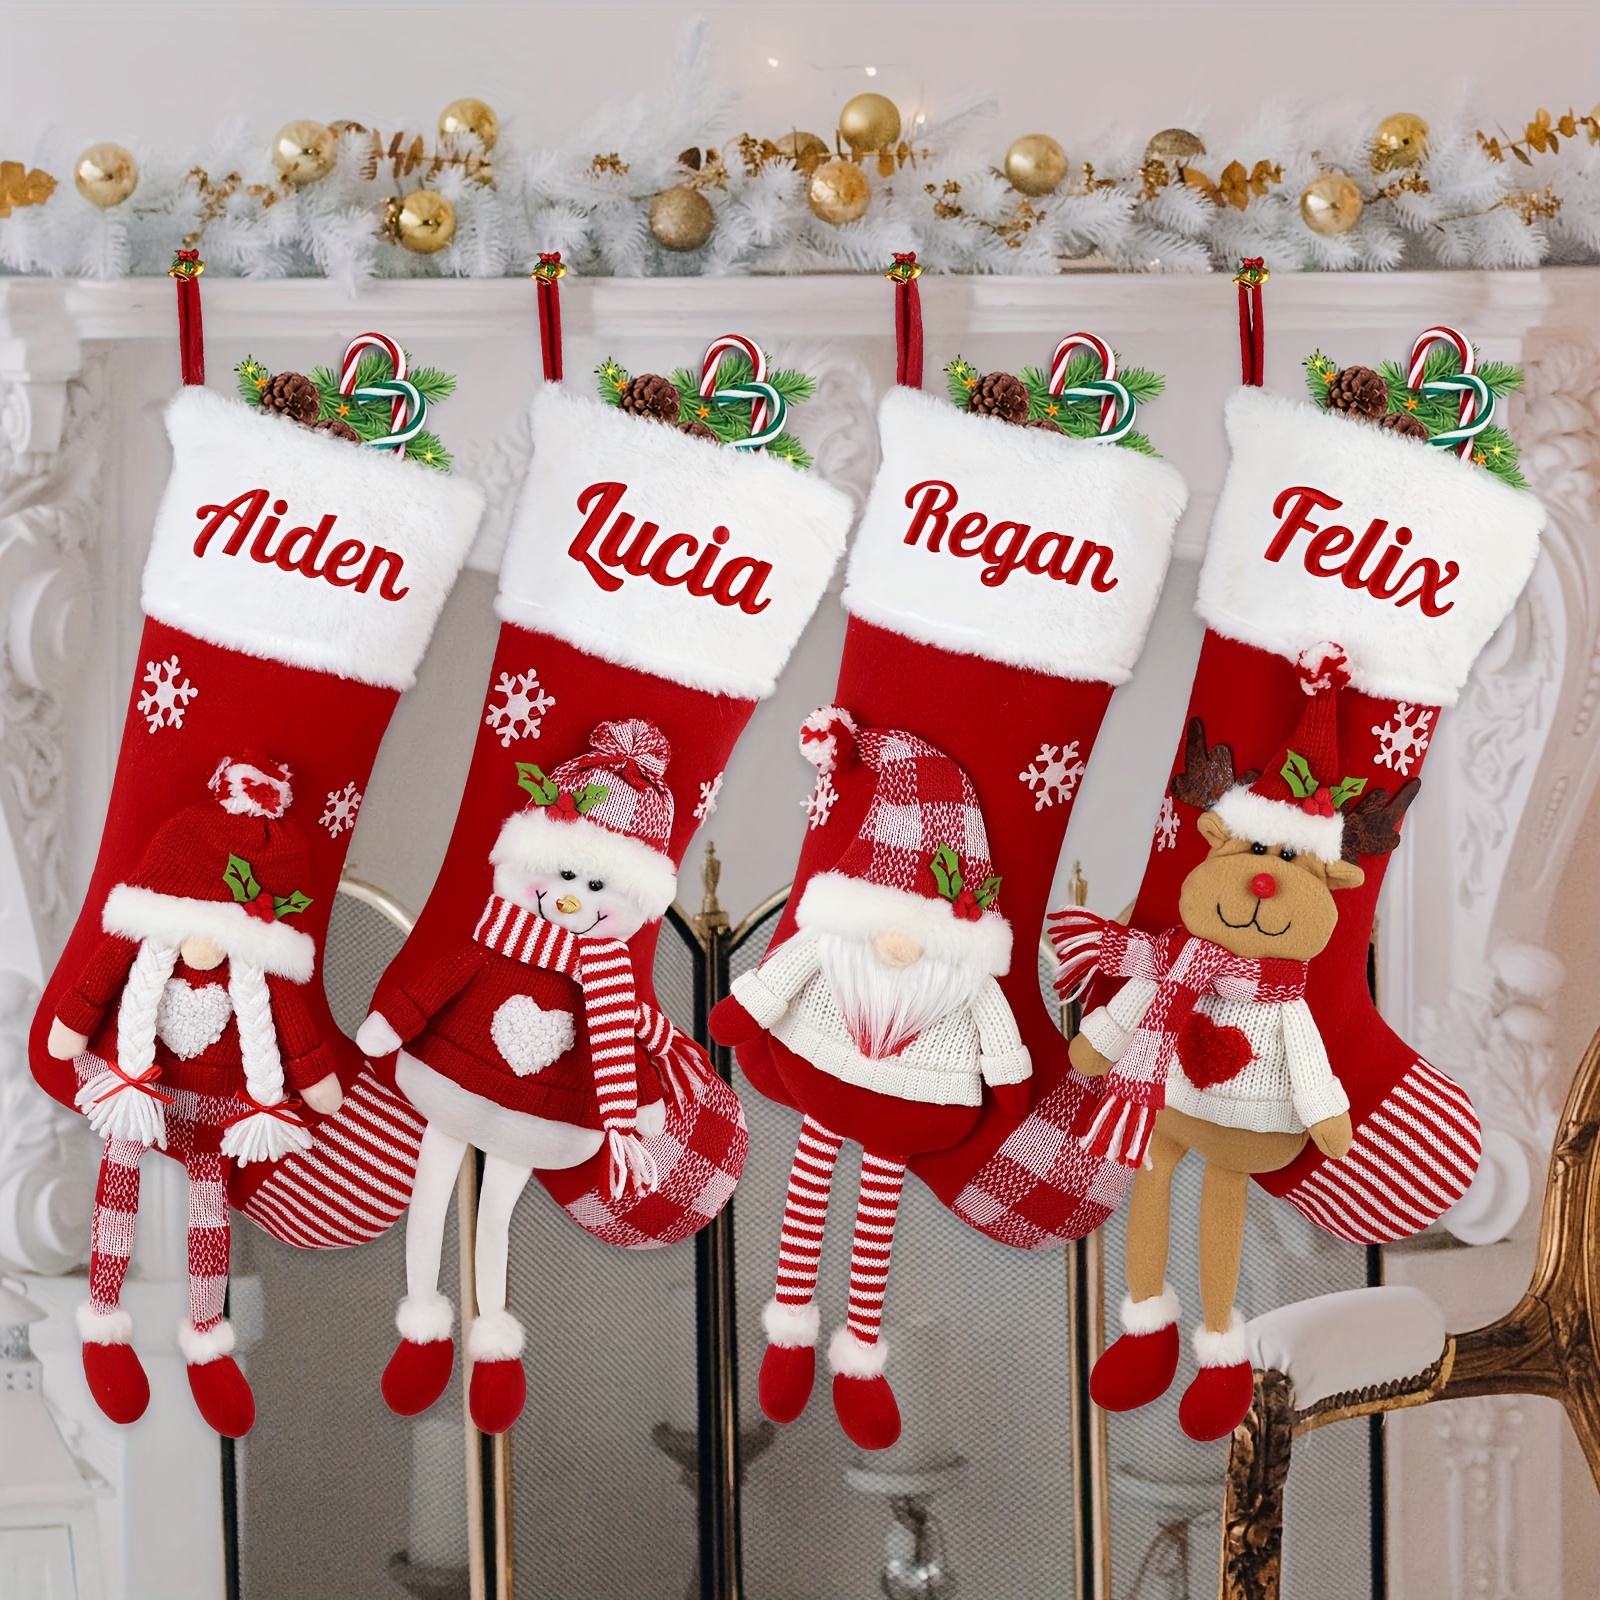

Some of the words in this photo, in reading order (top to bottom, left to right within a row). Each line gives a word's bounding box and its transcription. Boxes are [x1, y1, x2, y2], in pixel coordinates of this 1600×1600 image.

[193, 488, 409, 602] Aiden
[567, 481, 773, 616] Lucia
[903, 479, 1119, 593] Regan
[1263, 485, 1460, 619] Felix
